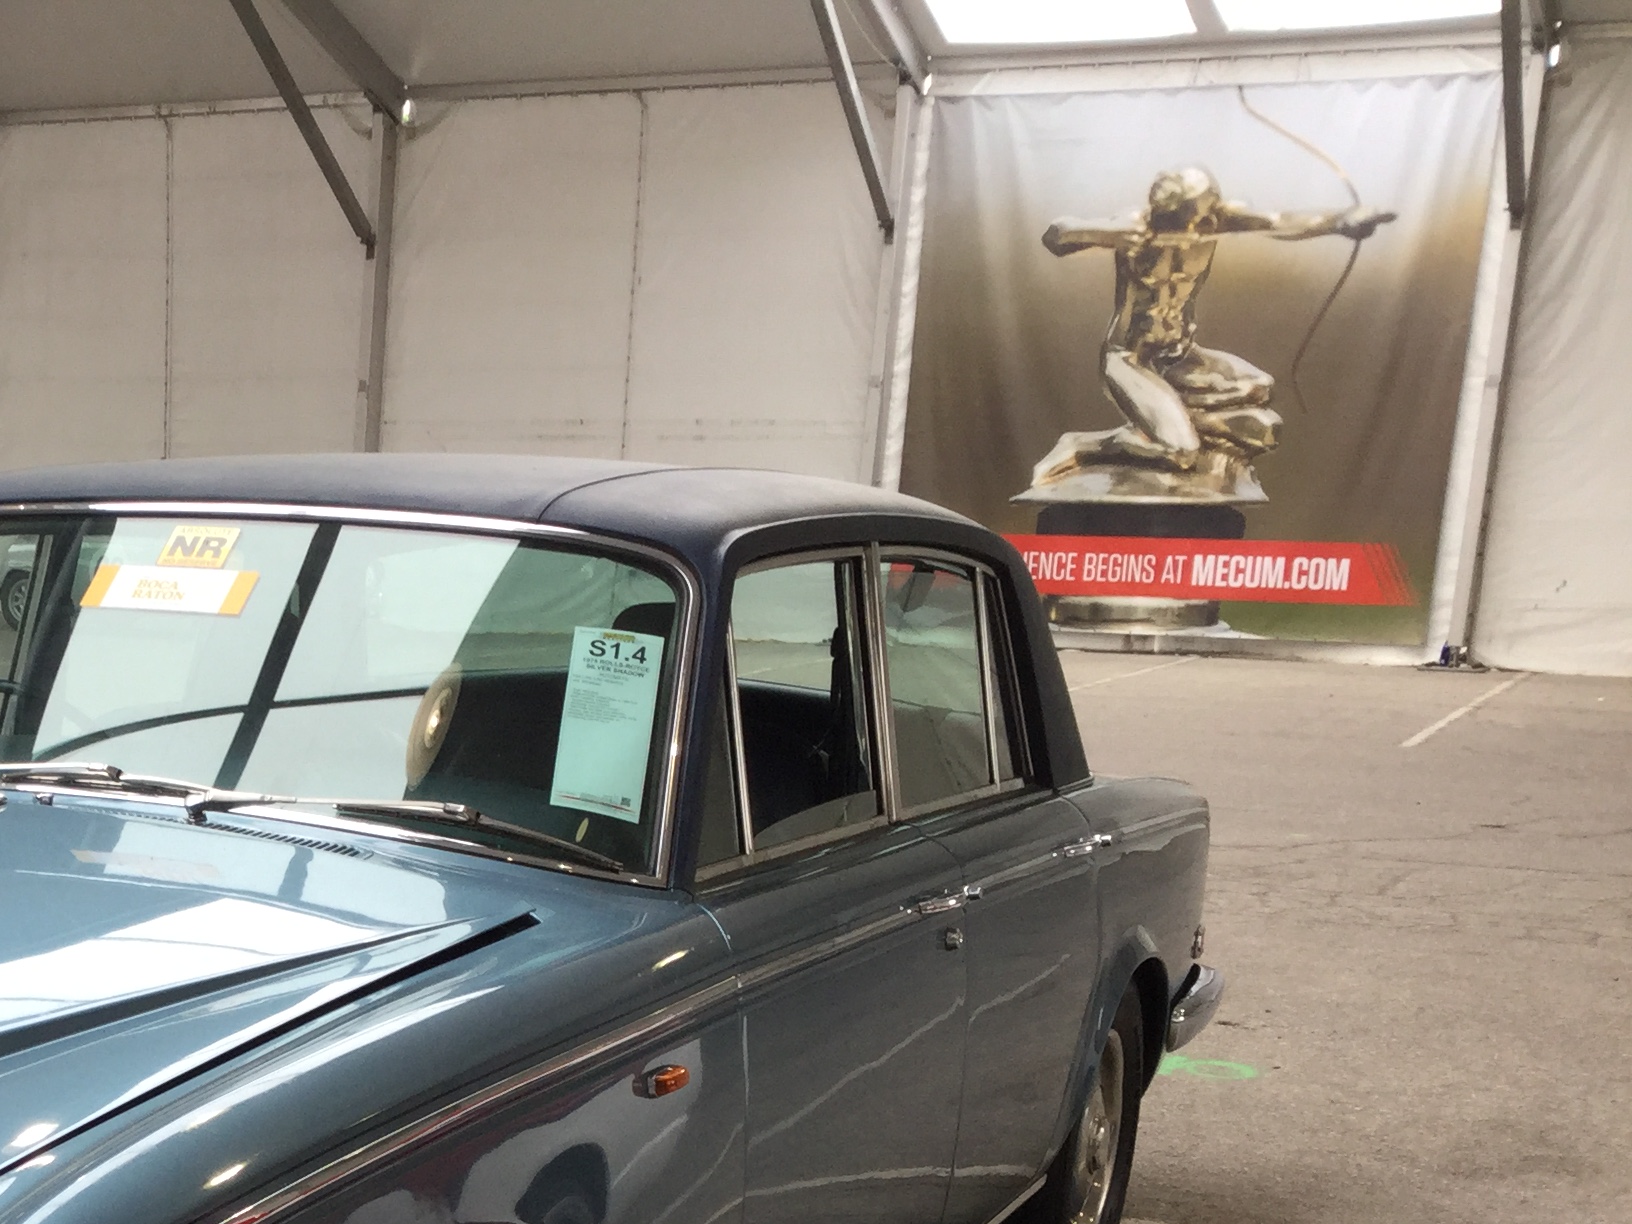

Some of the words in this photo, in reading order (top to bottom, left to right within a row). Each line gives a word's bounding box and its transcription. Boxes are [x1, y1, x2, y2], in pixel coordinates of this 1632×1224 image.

[166, 535, 228, 559] NR
[1082, 552, 1156, 585] BEGINS
[1160, 555, 1188, 584] AT
[1191, 554, 1351, 592] MECUM.COM
[132, 589, 186, 601] RATON
[137, 579, 179, 590] BOCA
[588, 639, 647, 665] S1.4
